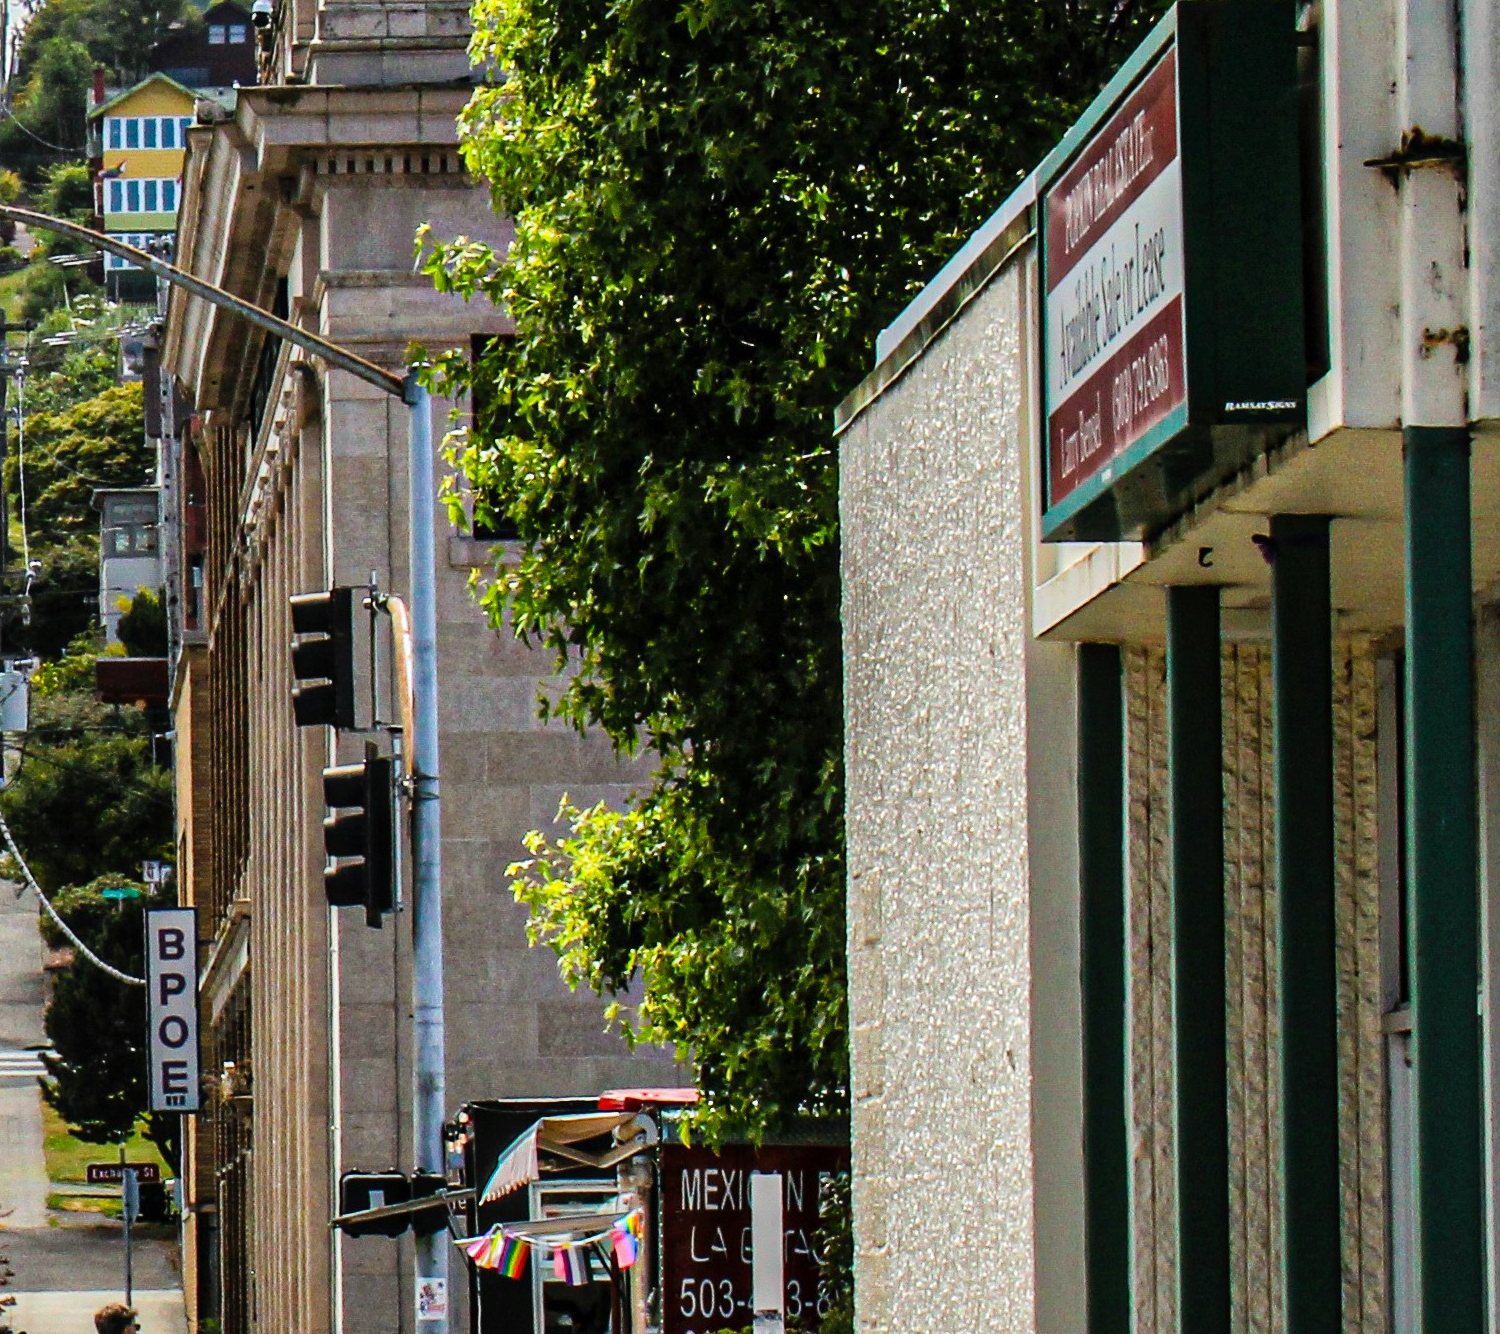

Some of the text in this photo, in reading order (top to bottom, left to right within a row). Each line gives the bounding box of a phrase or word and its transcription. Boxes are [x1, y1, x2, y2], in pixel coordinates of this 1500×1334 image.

[1059, 221, 1166, 390] Available Sale or Lease
[143, 1167, 154, 1178] St
